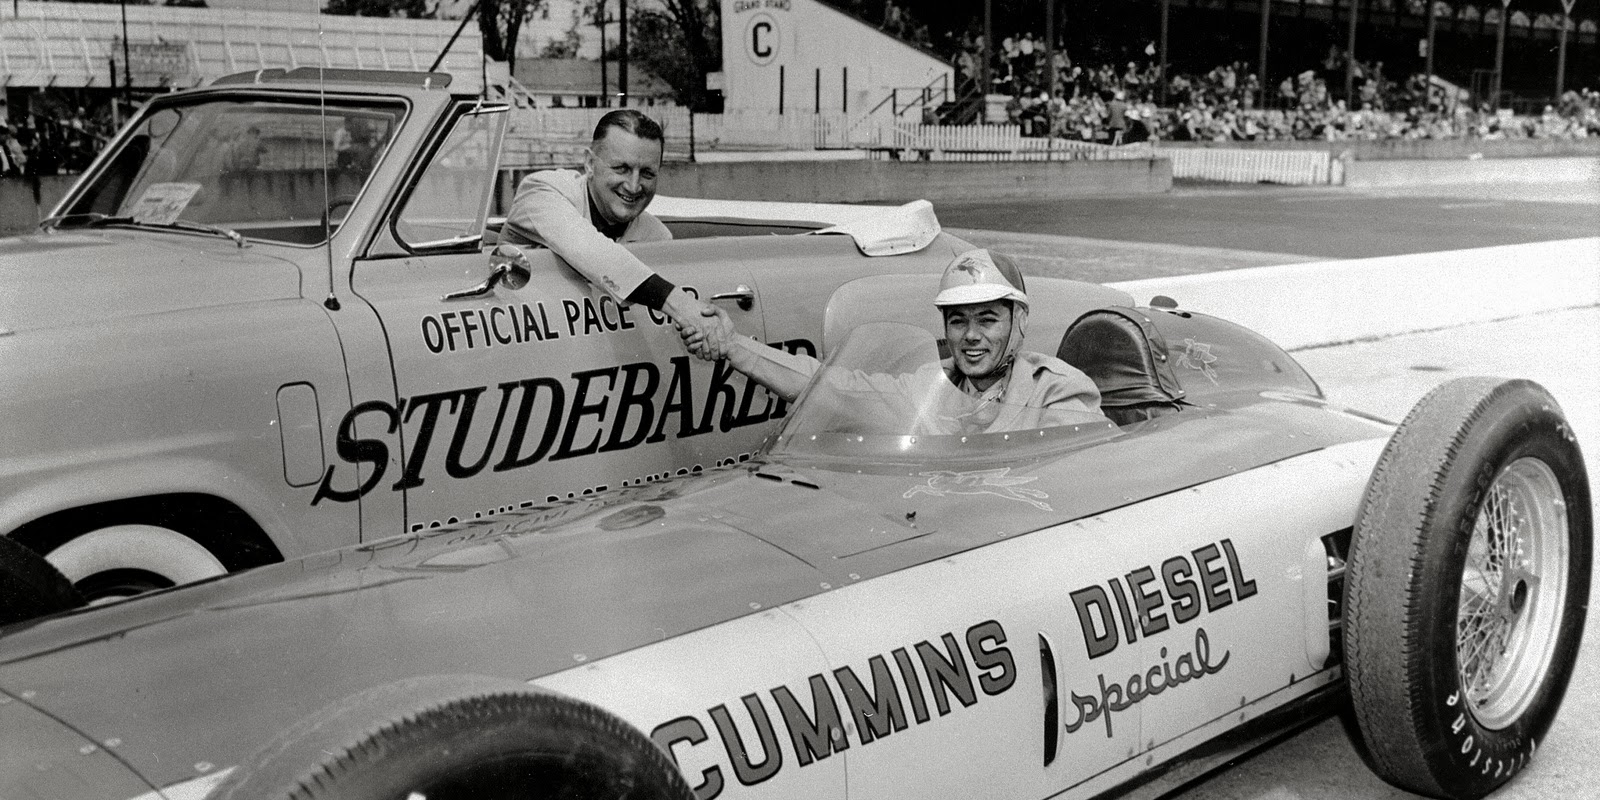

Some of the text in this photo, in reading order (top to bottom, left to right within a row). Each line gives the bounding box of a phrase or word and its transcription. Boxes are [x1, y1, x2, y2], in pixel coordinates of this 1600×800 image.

[752, 21, 772, 58] C
[421, 302, 560, 353] OFFICIAL
[562, 295, 636, 337] PACE
[650, 538, 1258, 800] CUMMINS DIESEL
[1065, 627, 1230, 738] special
